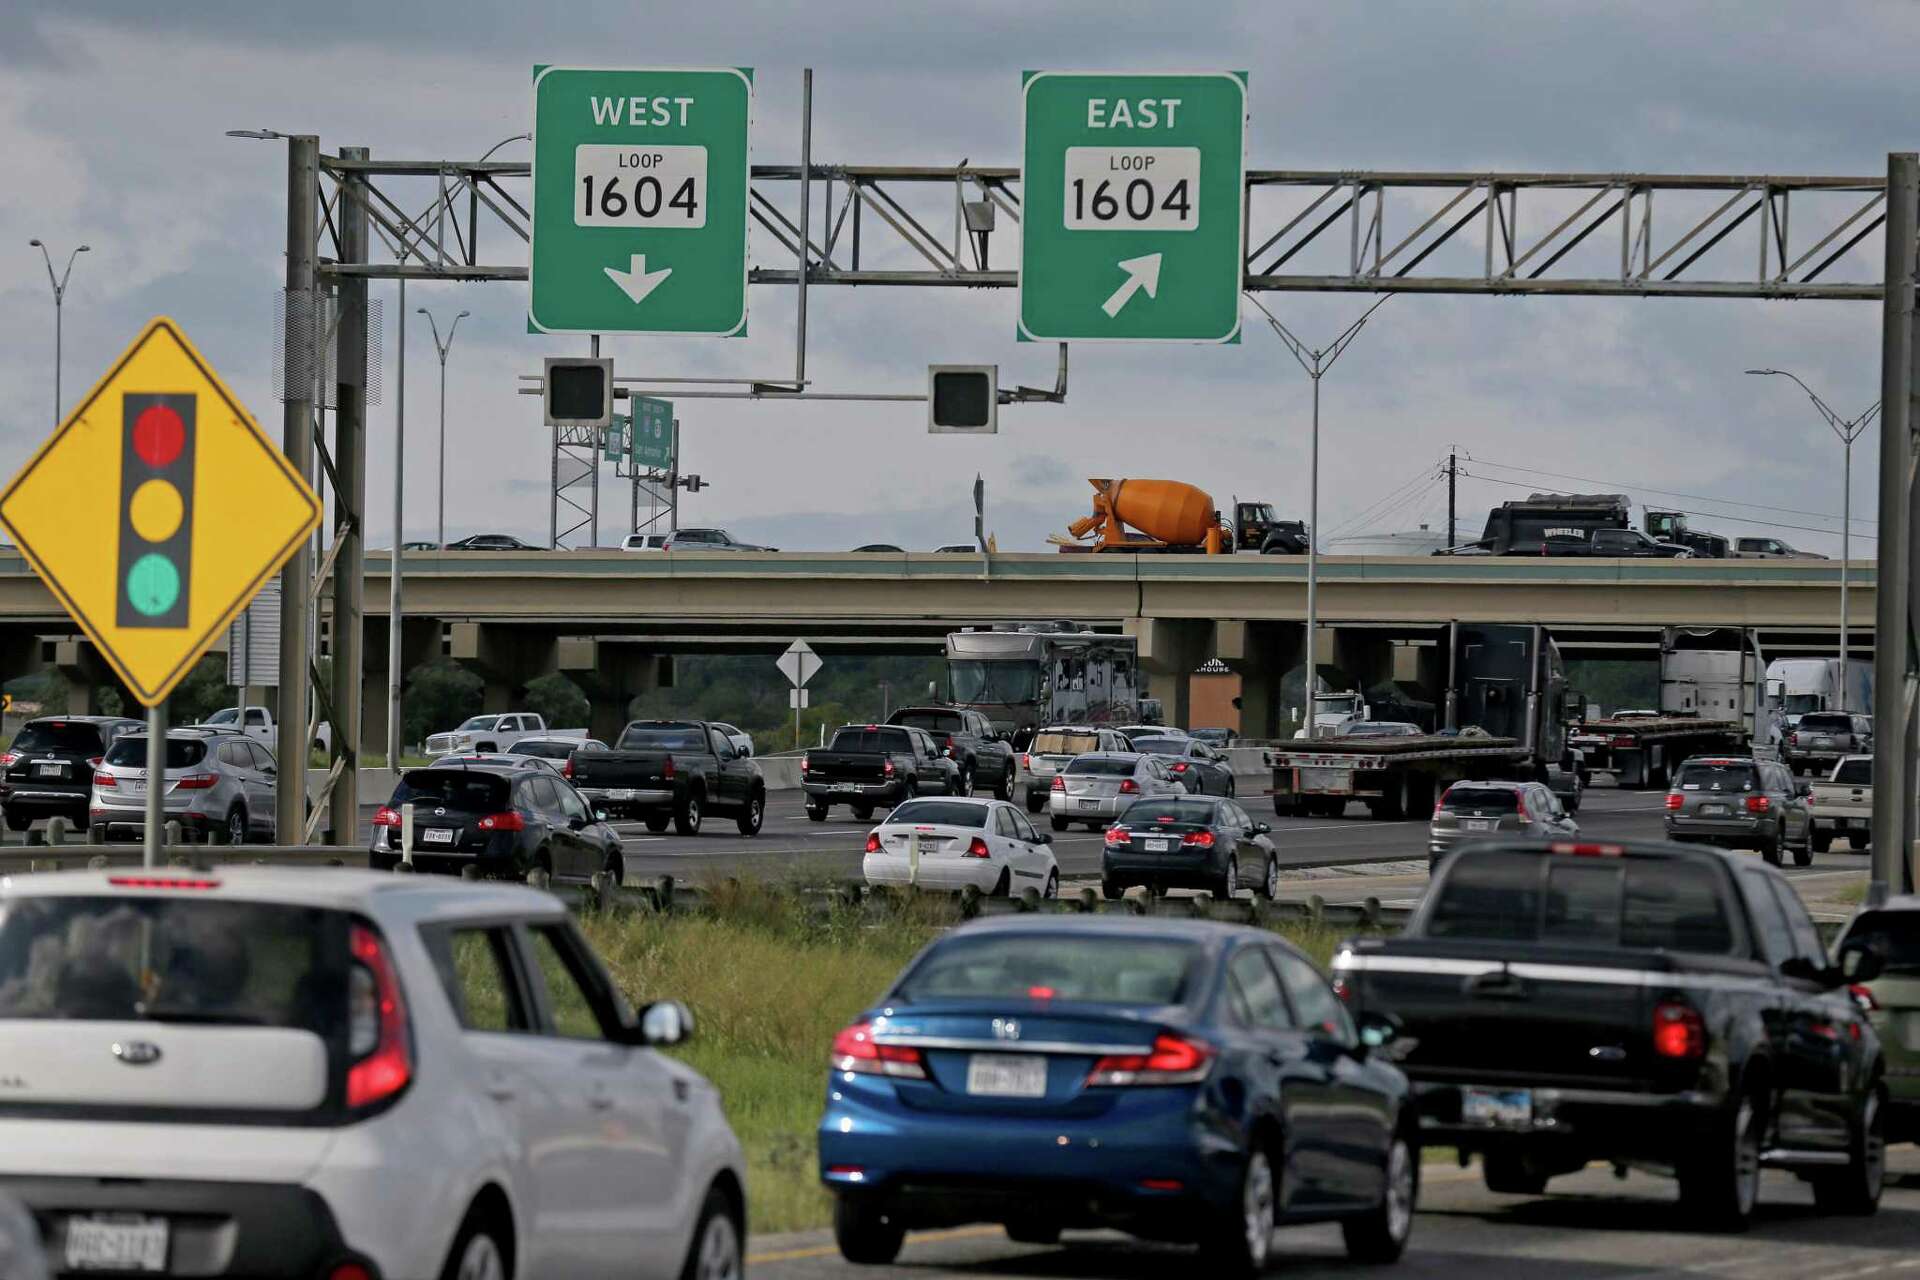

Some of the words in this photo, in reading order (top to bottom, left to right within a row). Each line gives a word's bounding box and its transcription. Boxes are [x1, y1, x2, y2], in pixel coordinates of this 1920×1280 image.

[590, 96, 694, 127] WEST
[1087, 98, 1182, 129] EAST
[619, 153, 663, 169] LOOP
[1110, 155, 1156, 171] LOOP
[582, 175, 698, 219] 1604
[1073, 178, 1191, 221] 1604
[1544, 528, 1585, 539] WHEELER
